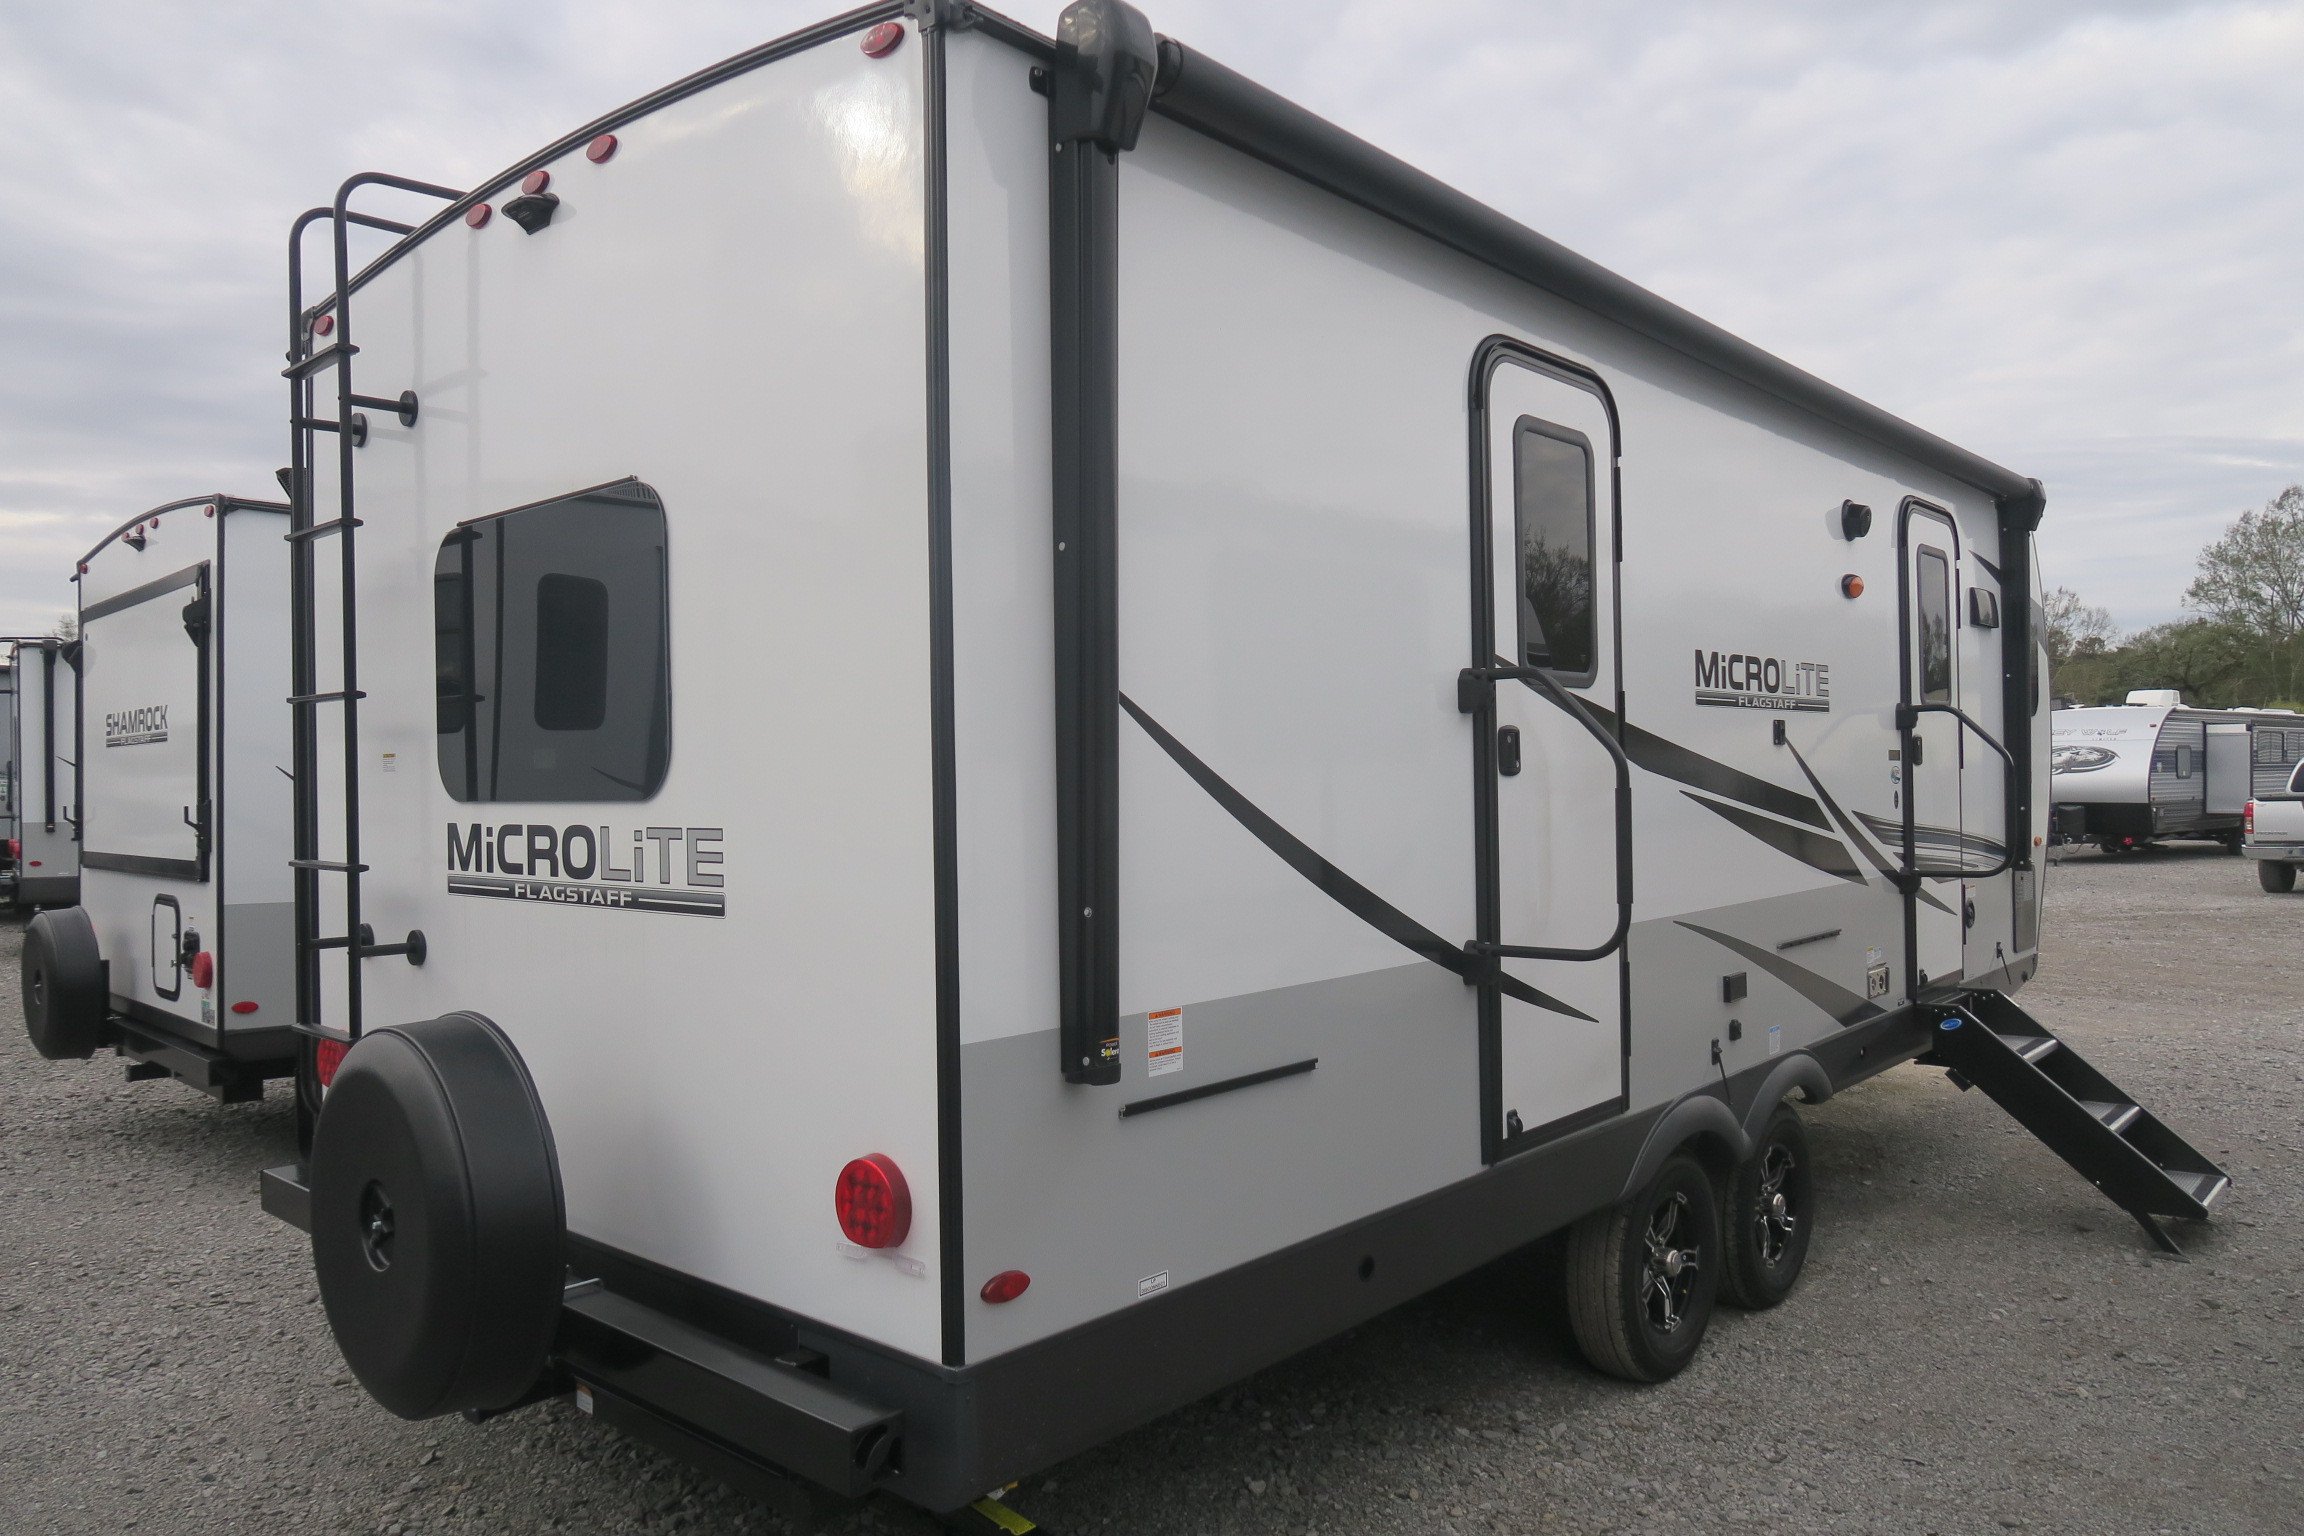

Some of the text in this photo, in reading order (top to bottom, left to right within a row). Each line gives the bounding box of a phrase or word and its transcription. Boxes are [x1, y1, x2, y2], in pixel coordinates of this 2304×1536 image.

[1738, 696, 1797, 710] FLAGSTAFF
[105, 705, 168, 736] SHAMROCK
[514, 882, 632, 907] FLAGSTAFF
